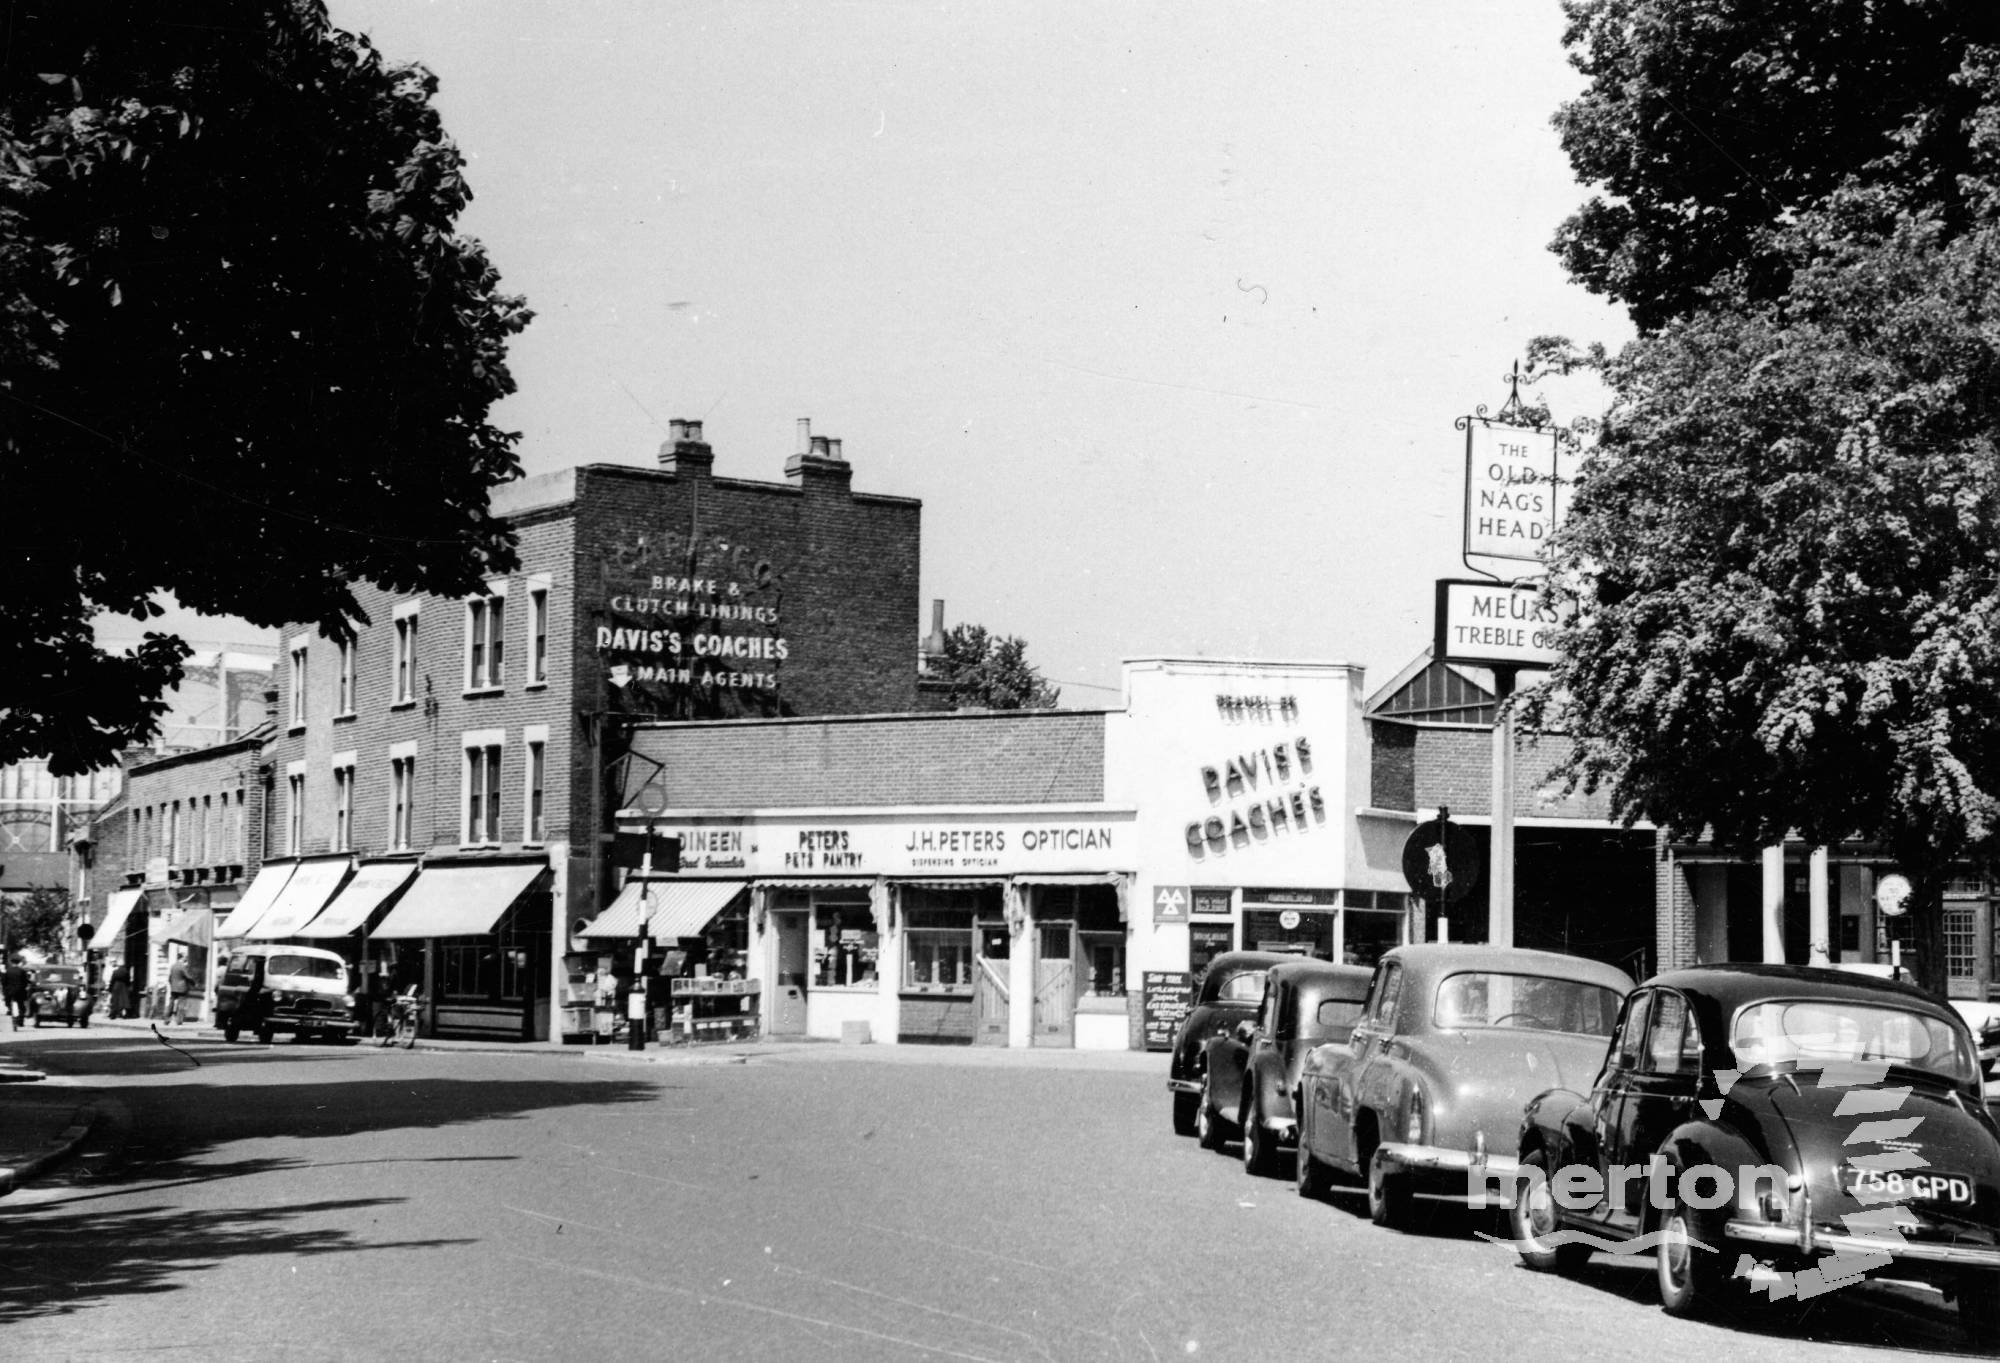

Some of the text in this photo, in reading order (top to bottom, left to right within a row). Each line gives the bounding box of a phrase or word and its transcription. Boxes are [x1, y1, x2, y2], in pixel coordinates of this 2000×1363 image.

[1498, 443, 1528, 458] THE
[1488, 463, 1536, 485] OLD
[1479, 517, 1543, 540] HEAD
[651, 575, 741, 596] BRAKE &
[610, 595, 778, 624] CLUTCH LININGS
[596, 626, 789, 660] DAVIS'S COACHES
[1454, 625, 1525, 647] TREBLE
[636, 665, 777, 689] MAIN AGENTS
[1185, 785, 1327, 863] COACHES
[1022, 827, 1112, 851] OPTICIAN
[785, 851, 863, 869] PETS PANTRY
[961, 857, 999, 868] OPTICIAN
[1847, 1168, 1970, 1202] 758 GPD
